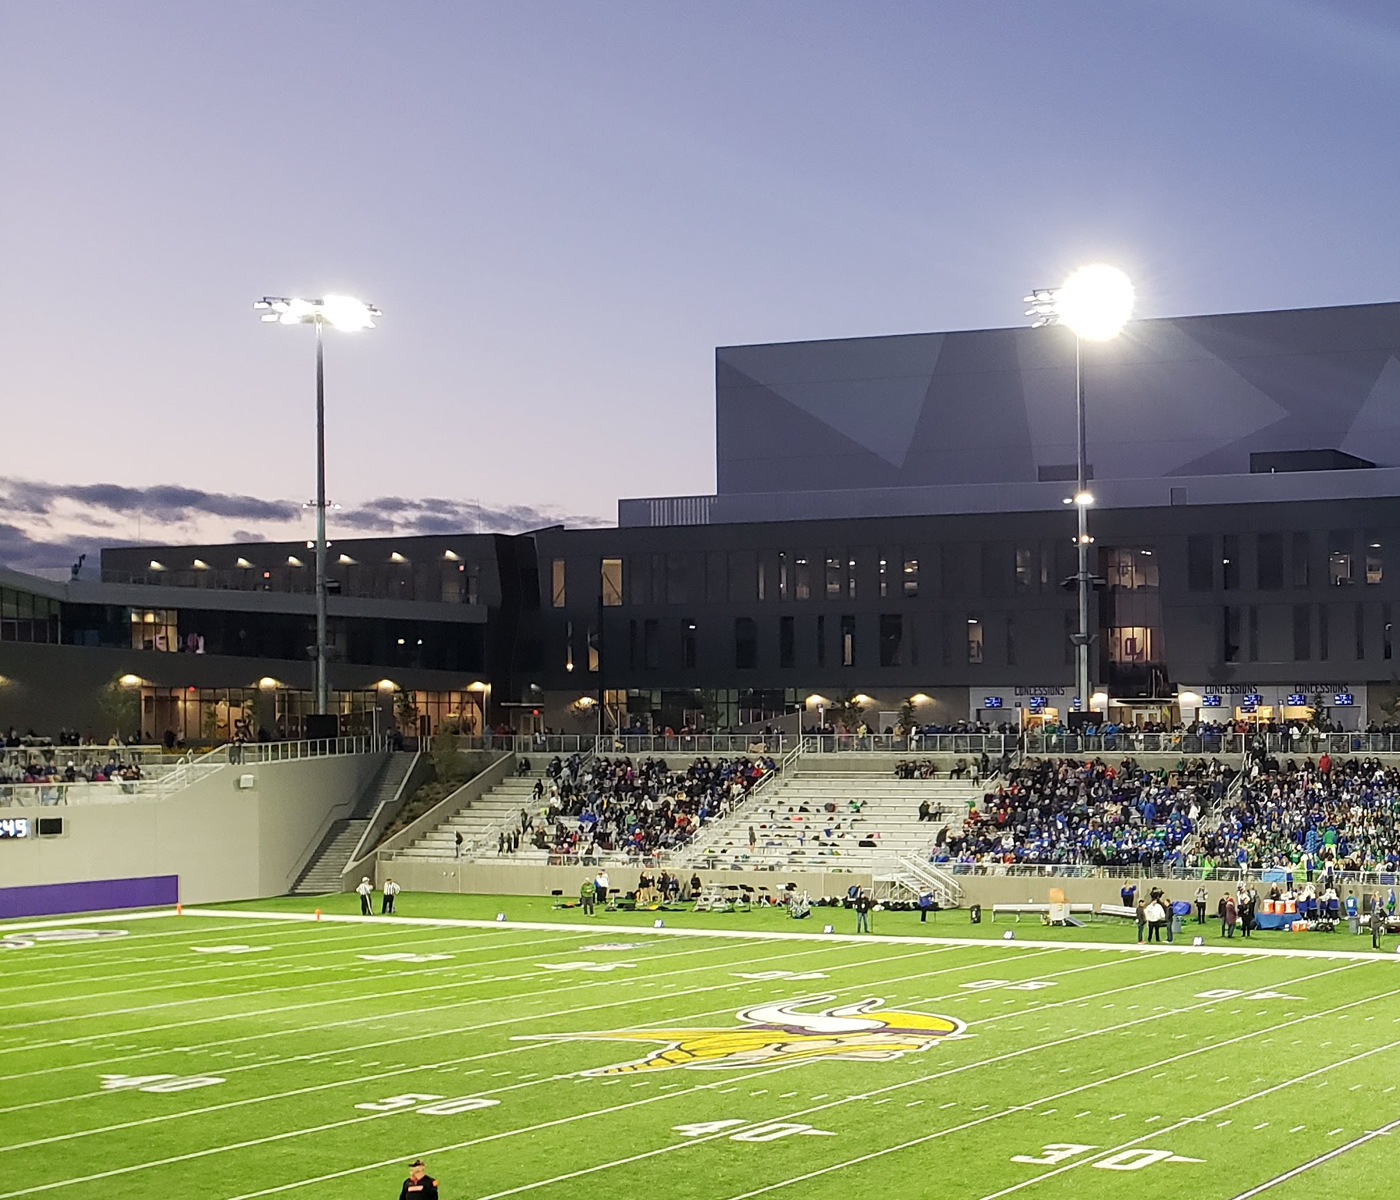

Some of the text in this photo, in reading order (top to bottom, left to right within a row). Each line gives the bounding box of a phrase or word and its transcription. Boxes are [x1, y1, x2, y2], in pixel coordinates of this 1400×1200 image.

[1014, 686, 1065, 696] CONCESSIONS
[1204, 684, 1258, 694] CONCESSIONS
[1294, 683, 1349, 694] CONCESSIONS
